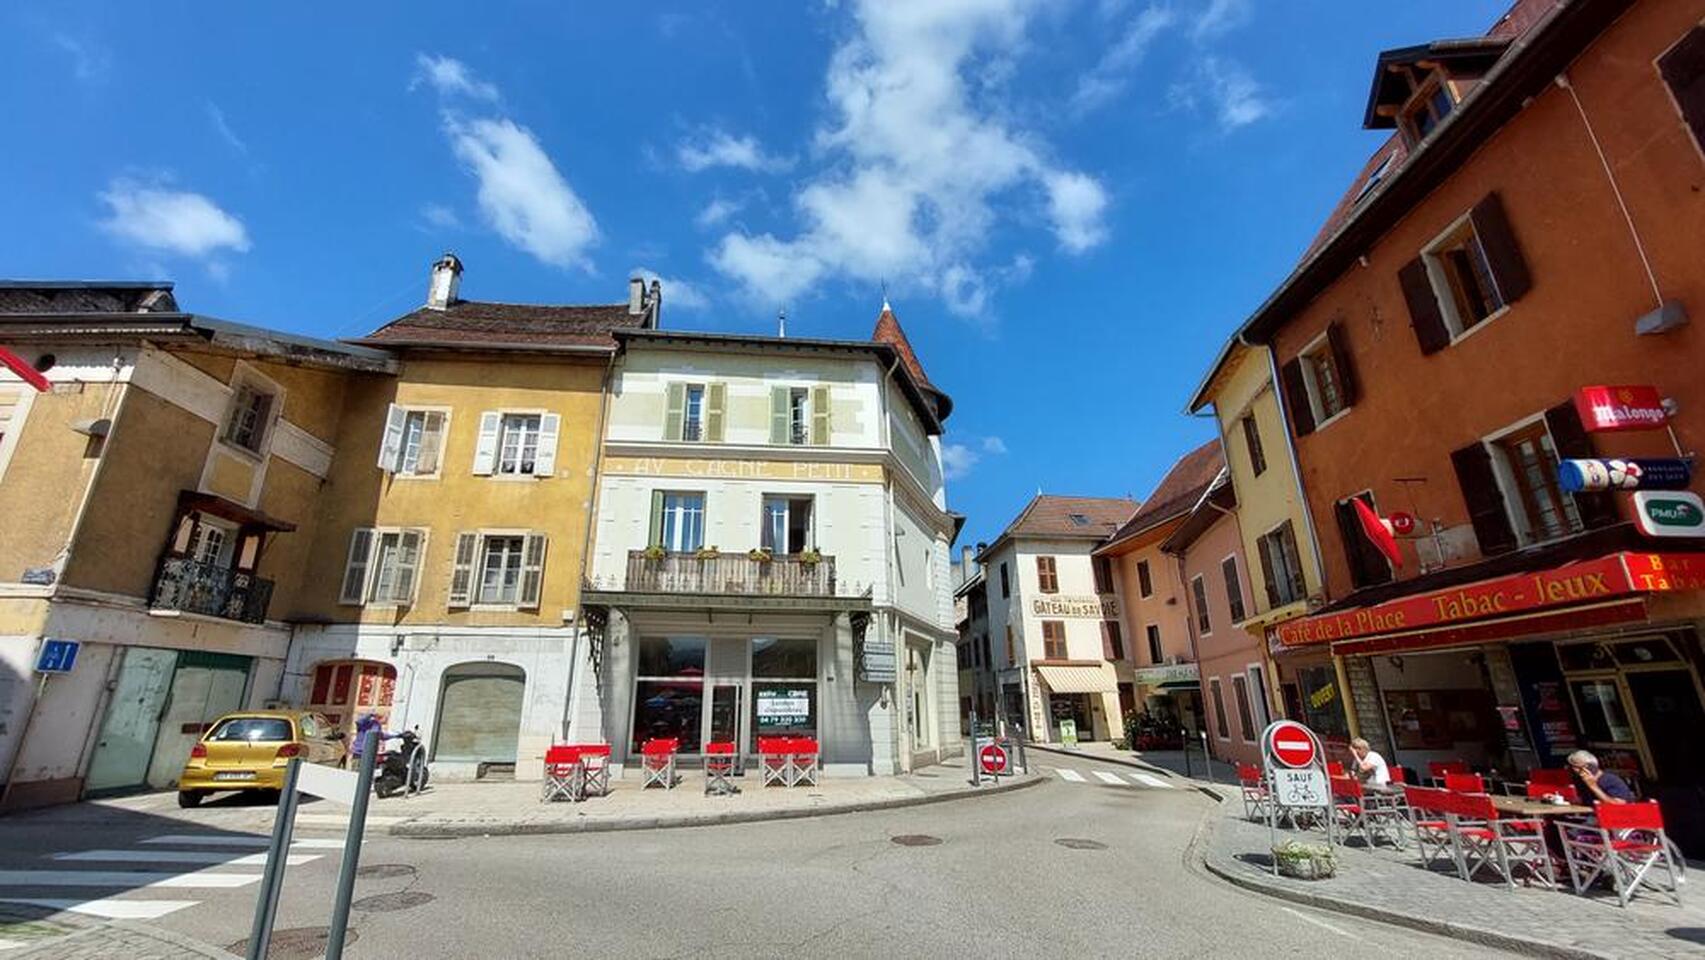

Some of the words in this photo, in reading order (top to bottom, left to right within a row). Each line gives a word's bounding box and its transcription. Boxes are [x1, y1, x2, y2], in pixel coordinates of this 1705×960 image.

[1592, 404, 1664, 423] Malongo
[793, 461, 851, 479] PETIT
[1651, 508, 1676, 518] PMU
[1648, 554, 1690, 571] Bar
[1082, 600, 1119, 616] SAVOIE
[1279, 621, 1313, 645] Café
[1315, 620, 1334, 639] de
[1336, 615, 1353, 637] la
[1356, 607, 1405, 632] Place
[1431, 591, 1504, 621] Tabac
[1533, 572, 1611, 605] Jeux
[1286, 773, 1313, 783] SAUF
